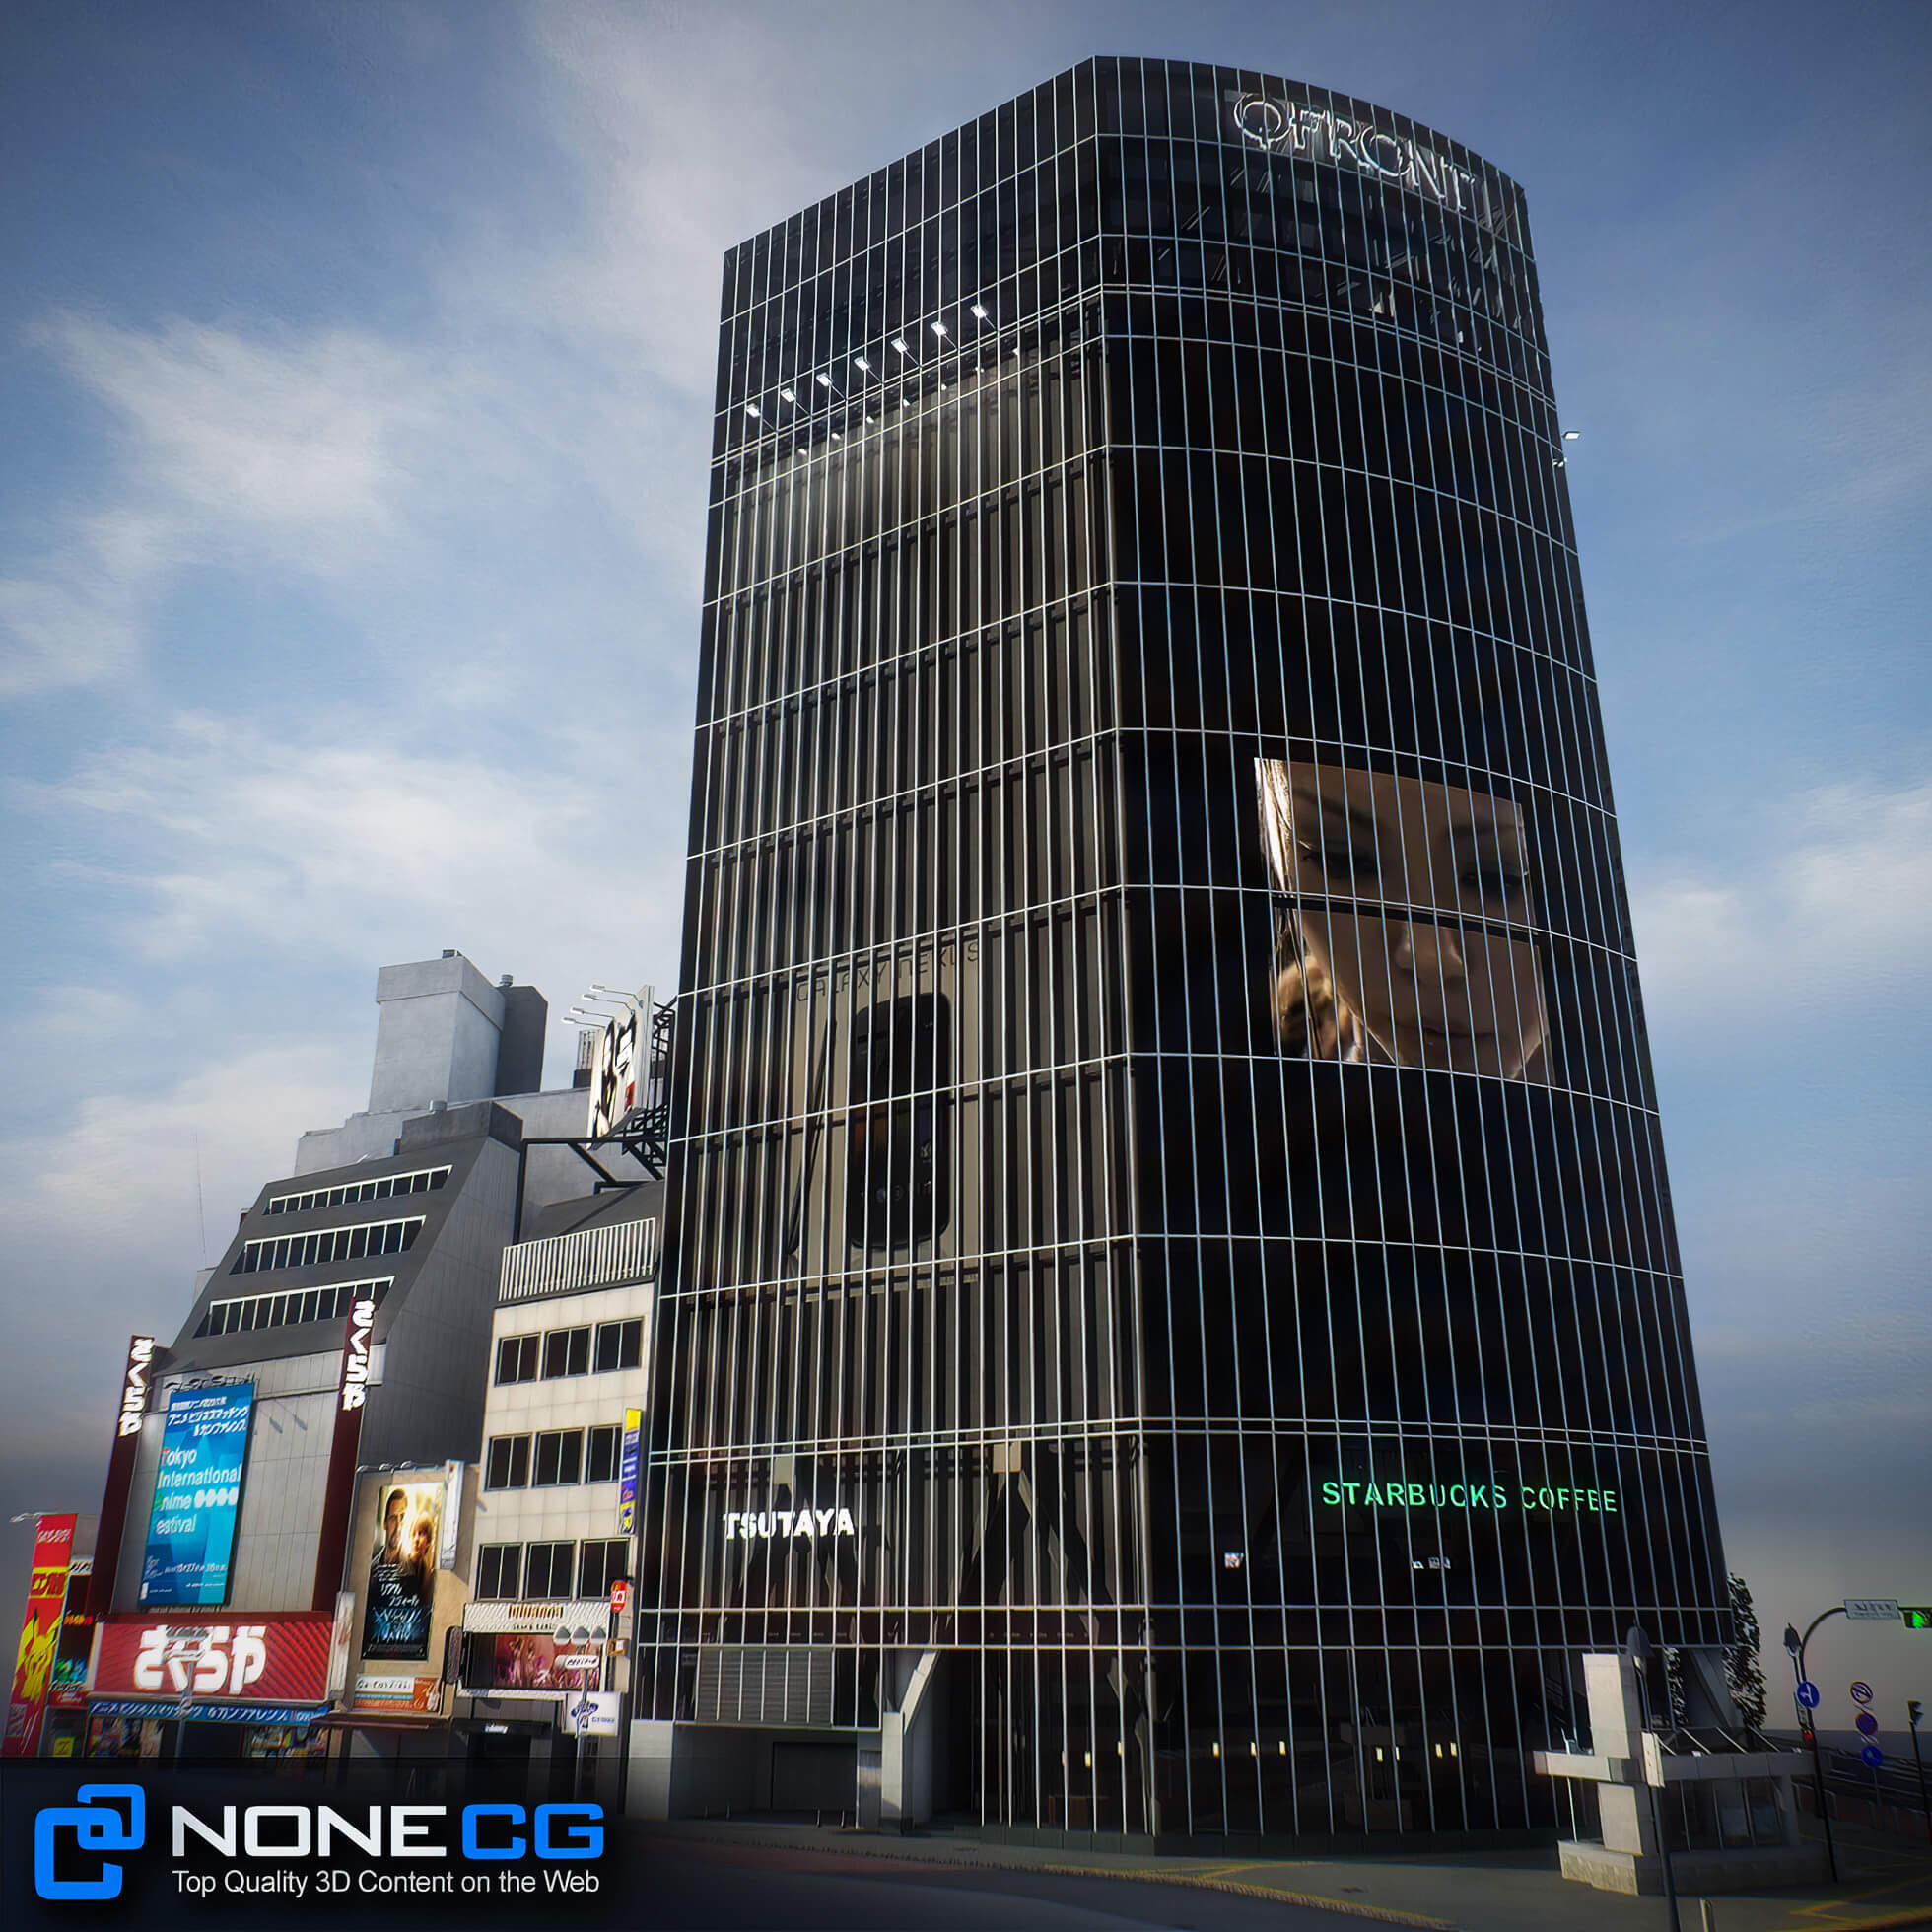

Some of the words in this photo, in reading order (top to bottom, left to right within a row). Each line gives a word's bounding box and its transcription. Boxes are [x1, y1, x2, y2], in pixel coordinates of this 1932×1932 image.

[1233, 93, 1476, 211] QFRONT
[349, 1300, 375, 1411] さくらや
[118, 1339, 154, 1437] さくらや
[161, 1446, 197, 1469] Tokyo
[158, 1464, 242, 1489] International
[1322, 1482, 1508, 1509] STARBUCKS
[1521, 1486, 1618, 1512] COFFEE
[723, 1508, 855, 1540] TSUTAYA
